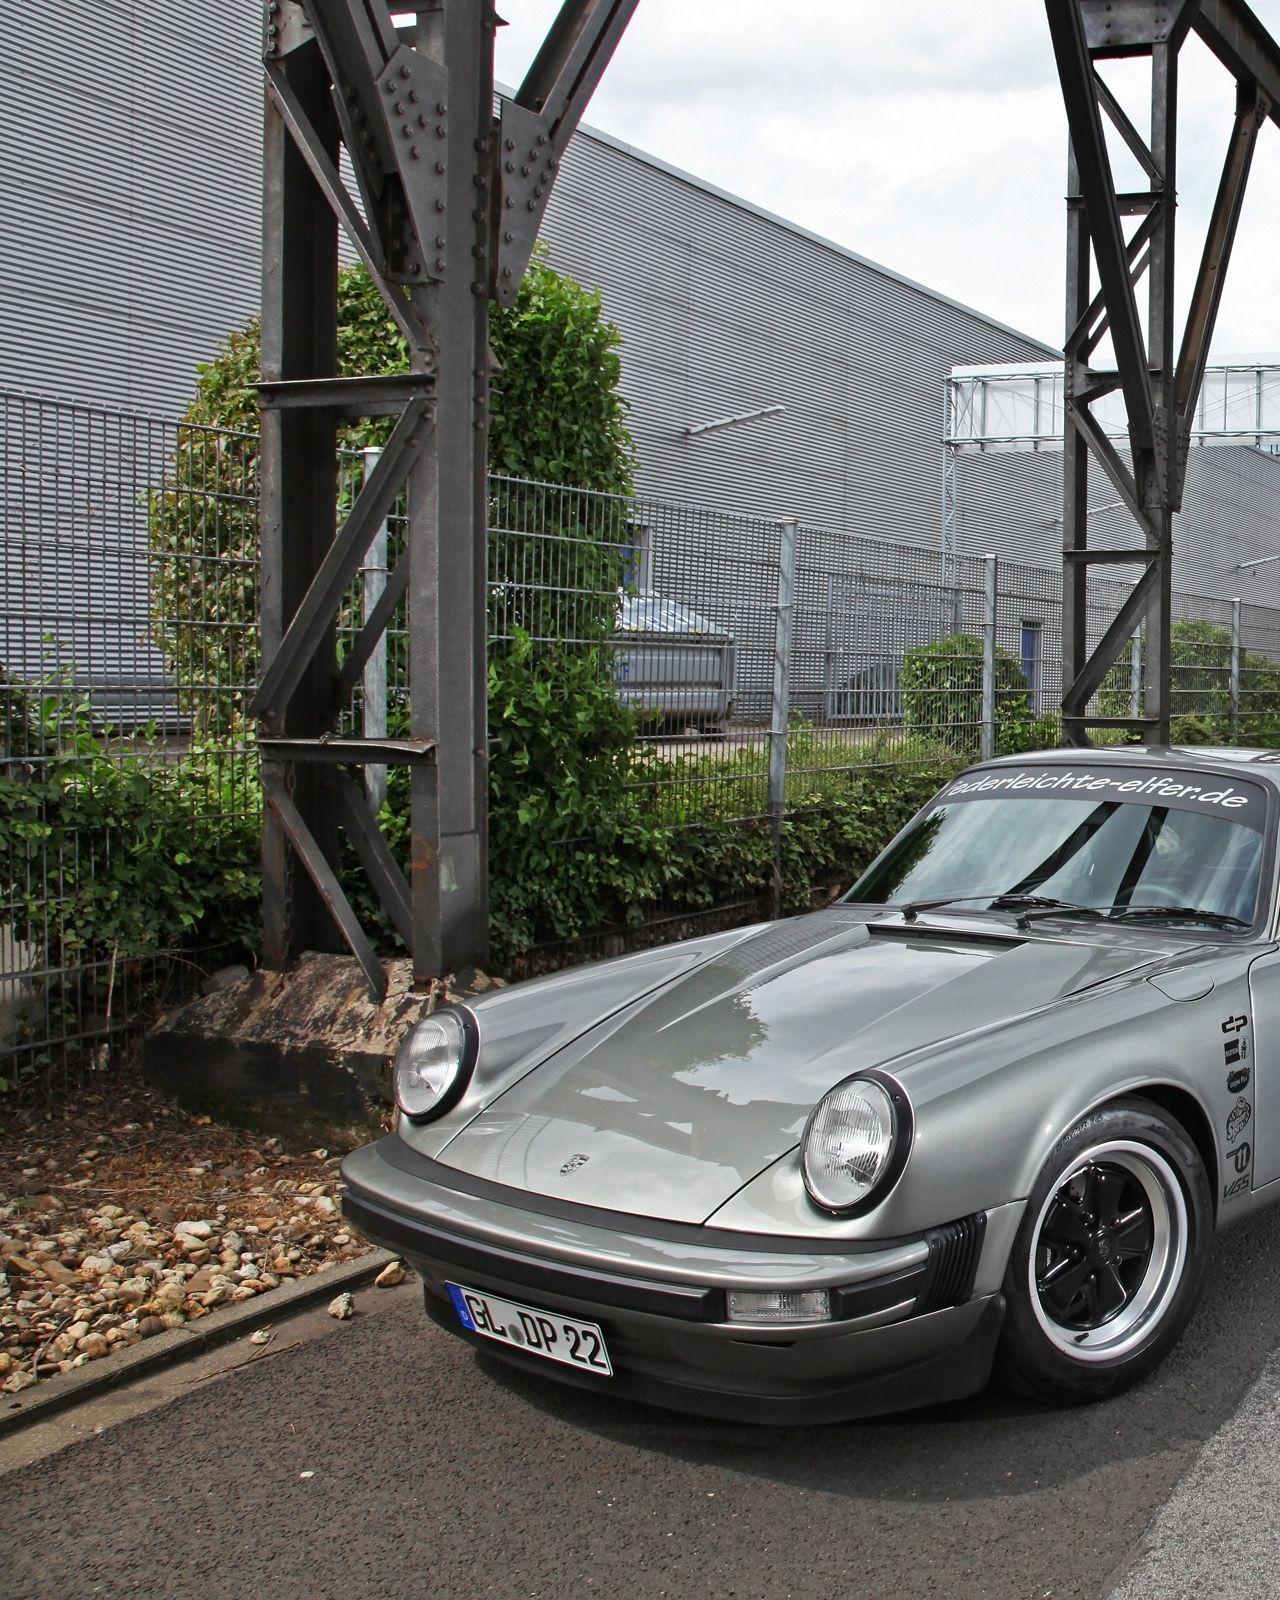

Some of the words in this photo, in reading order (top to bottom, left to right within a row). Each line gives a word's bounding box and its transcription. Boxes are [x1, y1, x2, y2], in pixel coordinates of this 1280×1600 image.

[465, 1294, 507, 1337] GL
[517, 1311, 557, 1352] DP
[563, 1324, 607, 1369] 22
